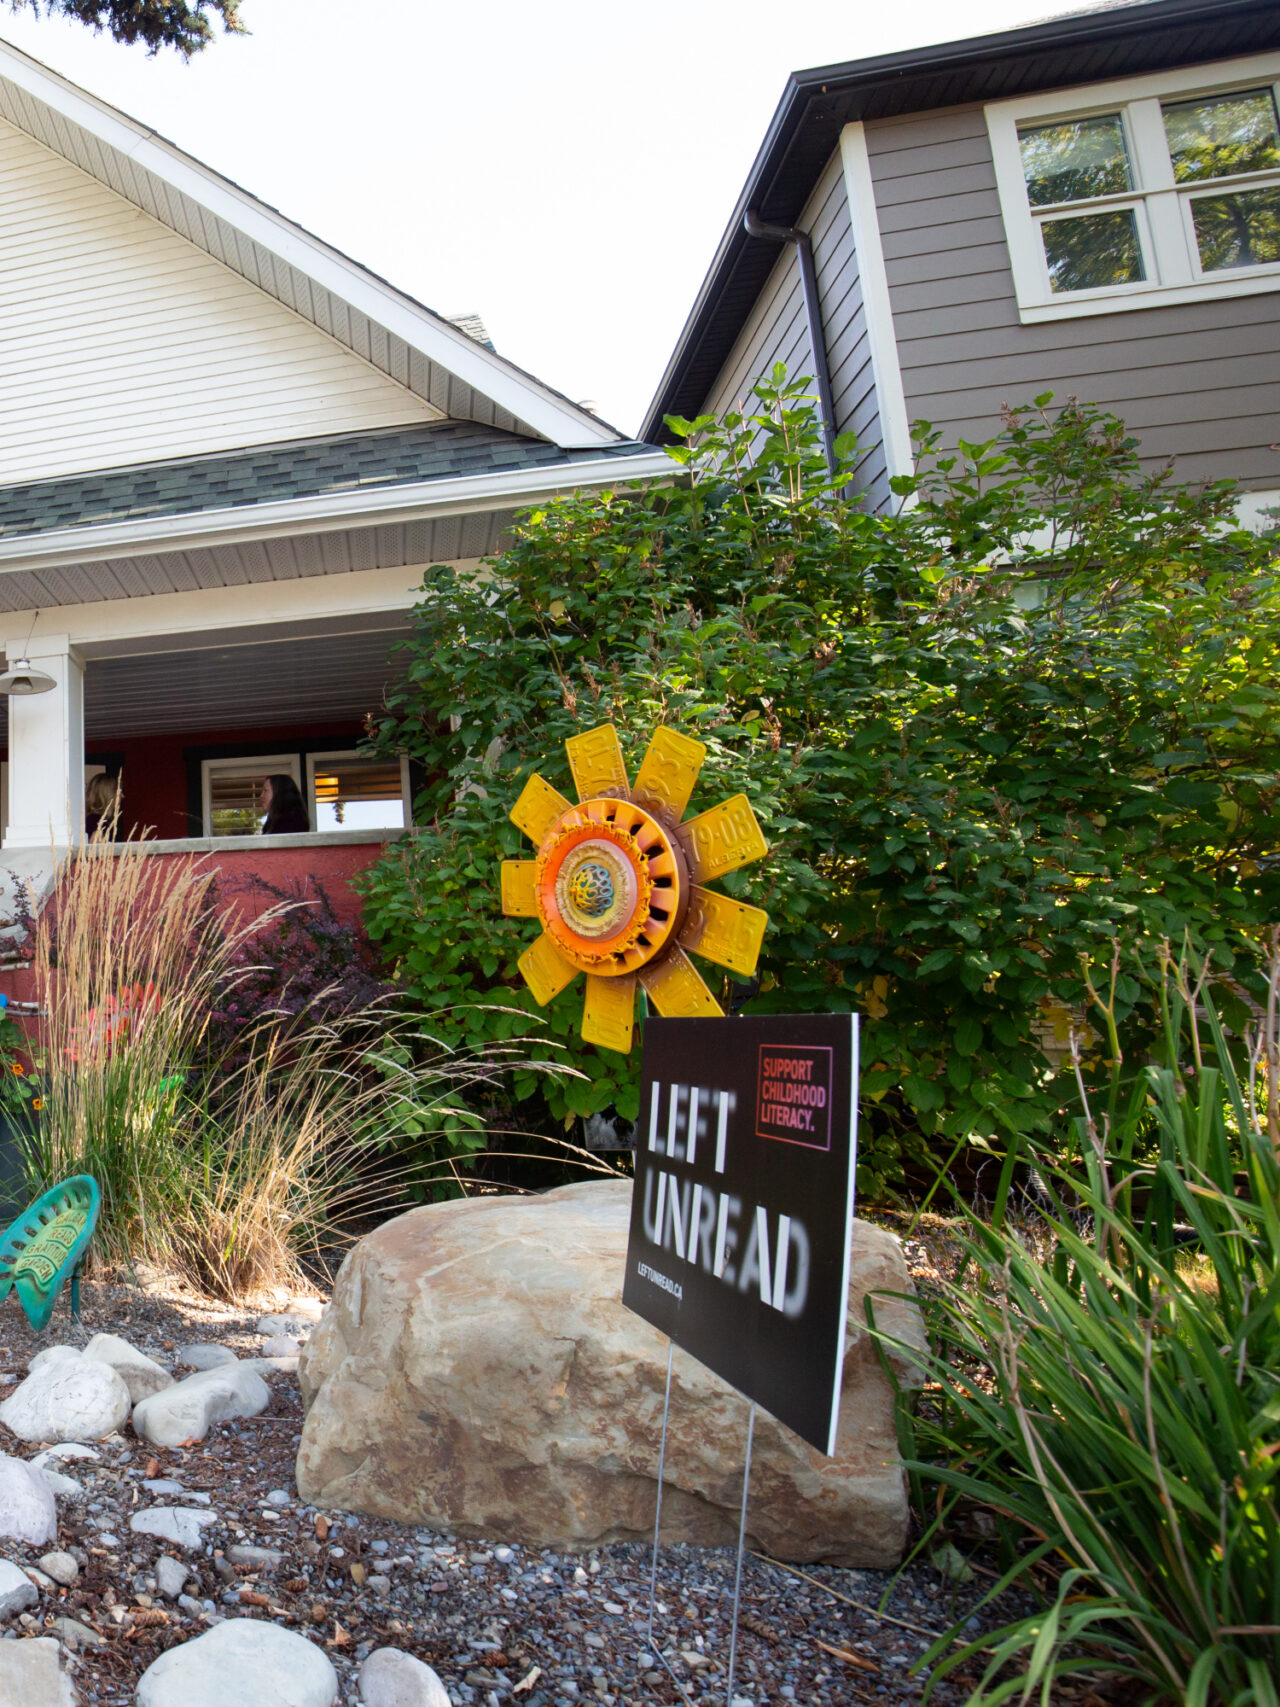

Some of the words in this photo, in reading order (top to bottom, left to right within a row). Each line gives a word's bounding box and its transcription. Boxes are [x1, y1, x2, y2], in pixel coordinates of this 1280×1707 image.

[763, 1057, 813, 1081] SUPPORT
[762, 1082, 826, 1109] CHILDHOOD
[648, 1081, 737, 1174] LEFT
[761, 1102, 815, 1132] LITERACY.
[642, 1166, 811, 1318] UNREAD
[20, 1258, 53, 1281] GARDEN
[637, 1261, 683, 1301] LEFTUNREAD.CA
